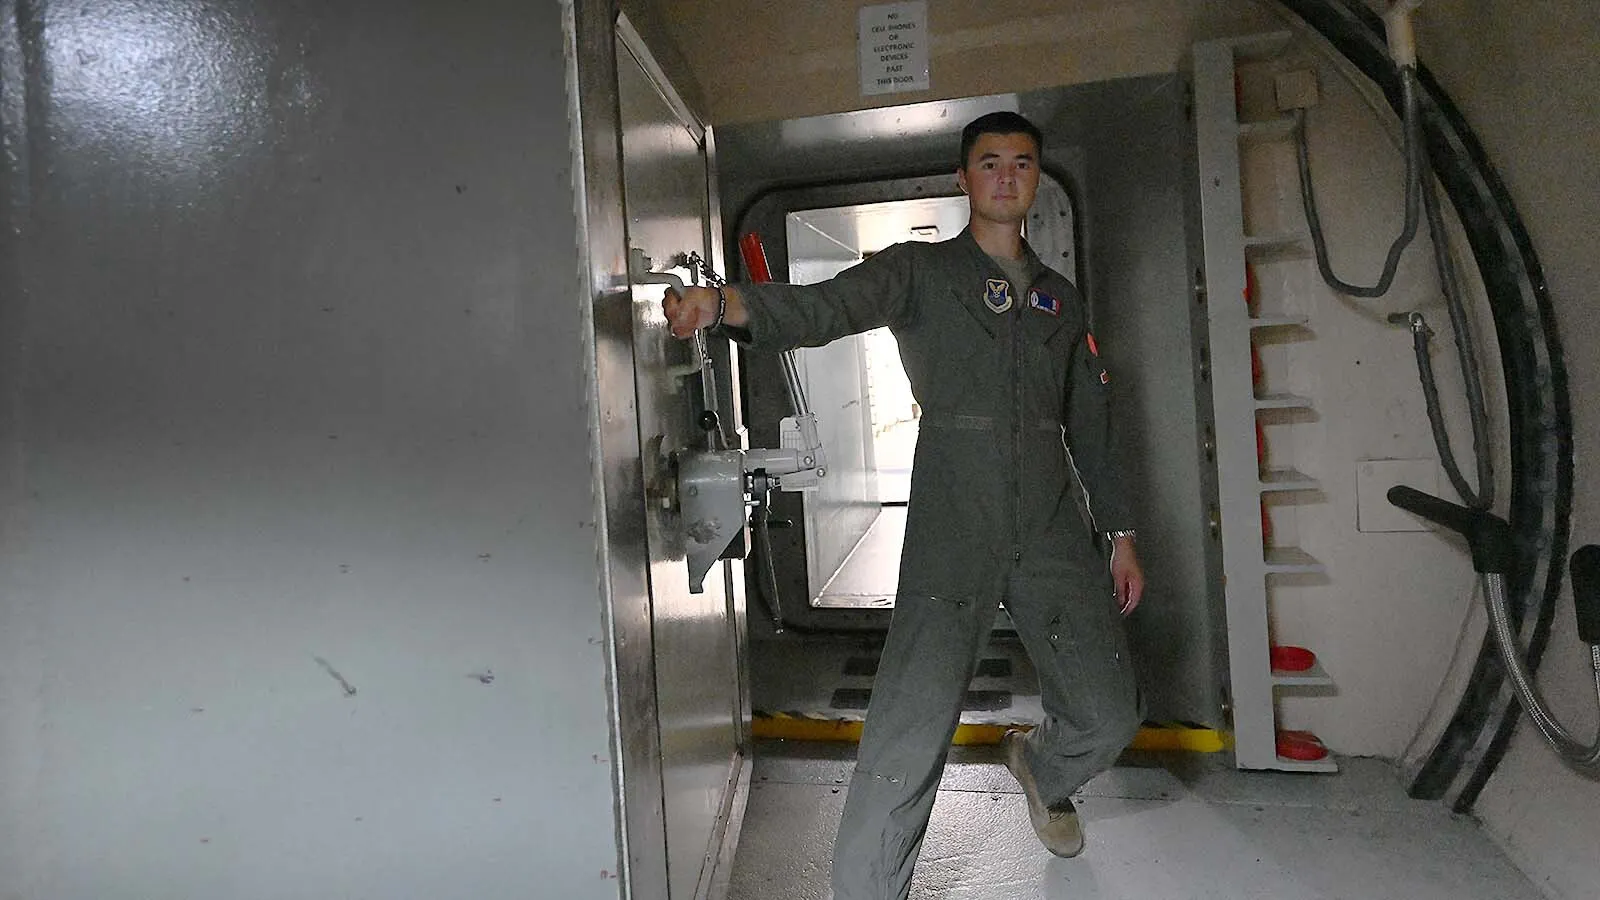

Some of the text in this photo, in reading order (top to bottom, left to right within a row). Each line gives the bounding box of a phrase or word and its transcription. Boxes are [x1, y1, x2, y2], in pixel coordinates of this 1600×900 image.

[888, 23, 916, 31] PHONES
[873, 42, 916, 52] ELECTRONIC
[880, 53, 909, 62] DEVICES
[886, 64, 903, 73] PAST
[876, 75, 914, 86] THIS DOOR
